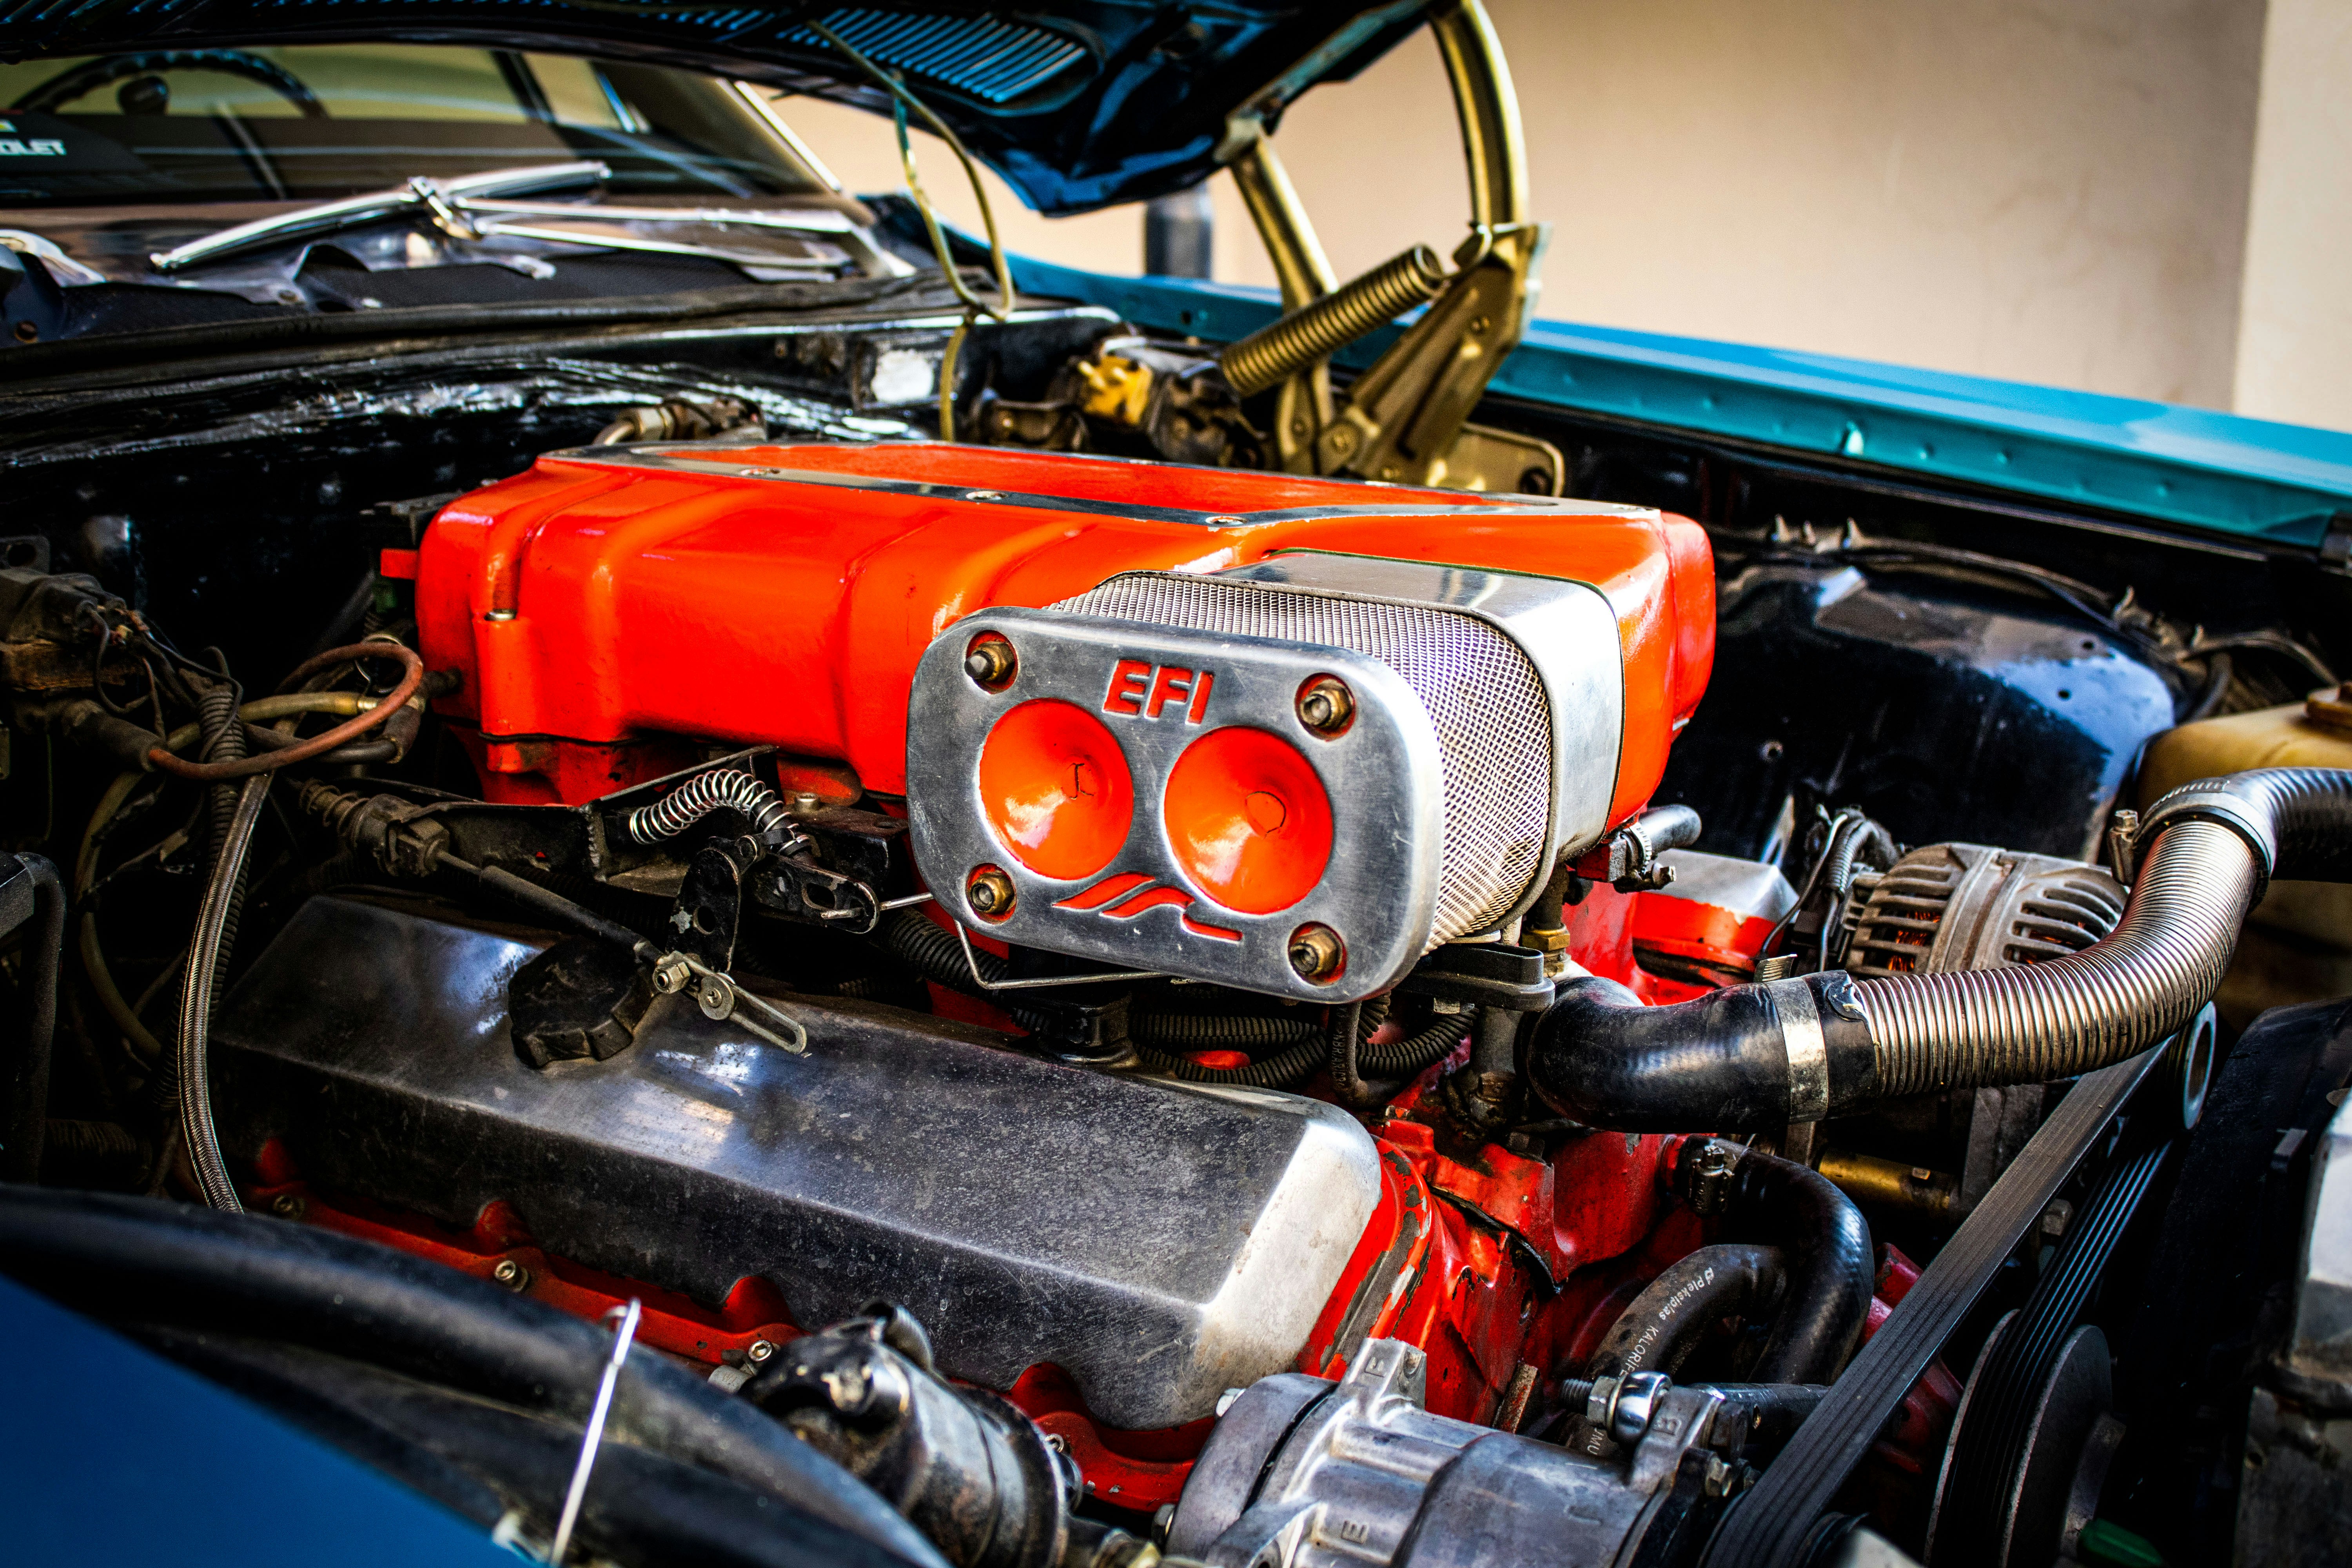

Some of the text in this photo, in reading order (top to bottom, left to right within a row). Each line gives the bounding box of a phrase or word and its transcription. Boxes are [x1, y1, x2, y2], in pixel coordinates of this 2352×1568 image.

[1102, 659, 1215, 726] EFI
[1659, 1275, 1705, 1320] Pleksiplas
[1341, 1520, 1369, 1544] E
